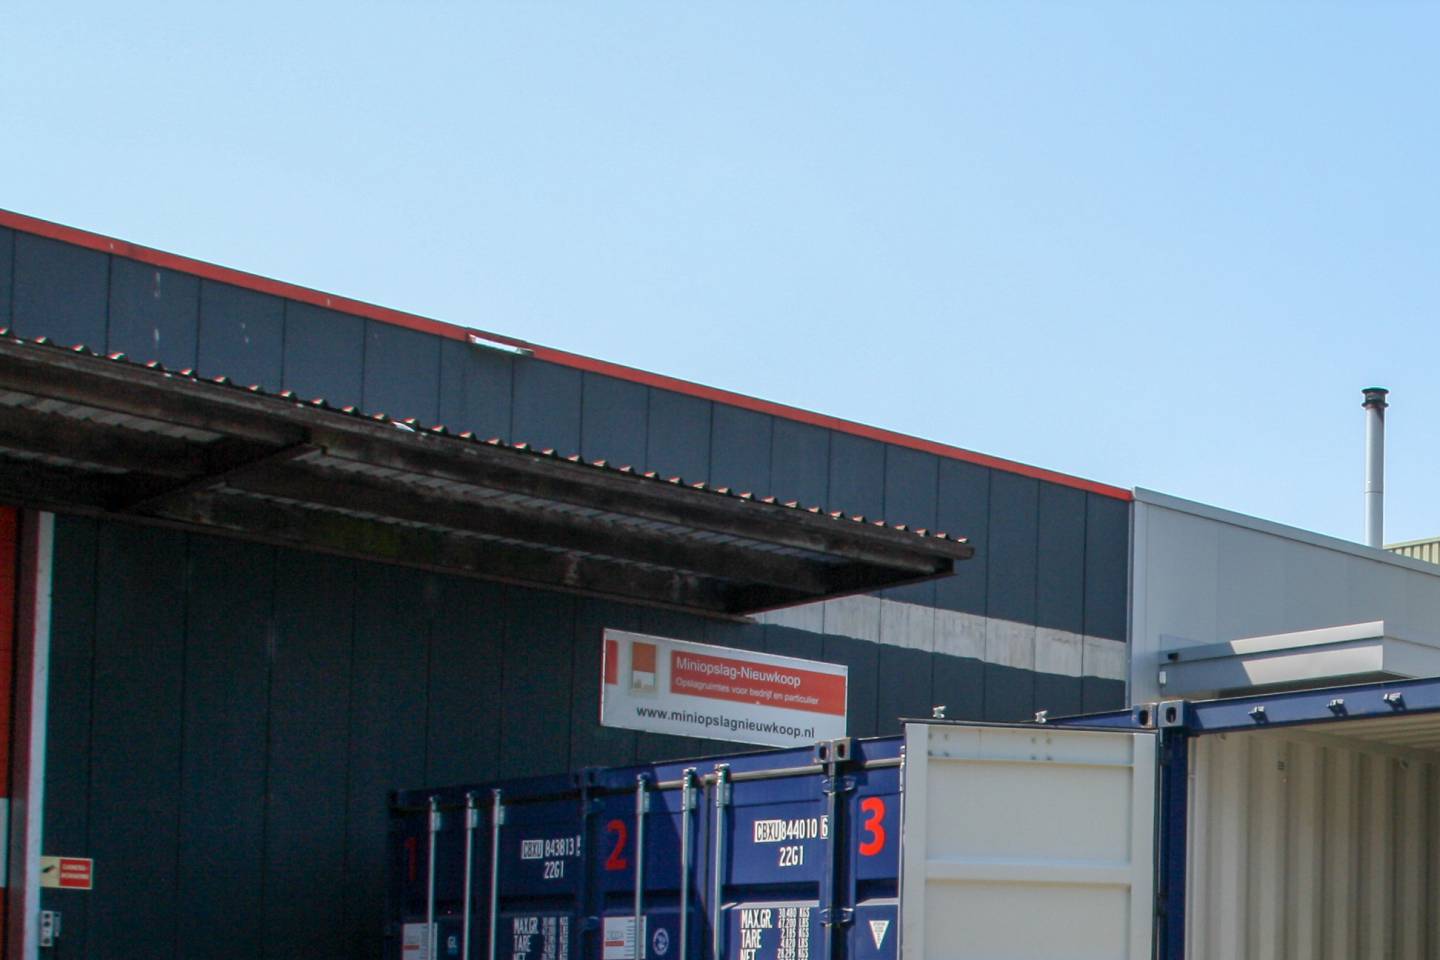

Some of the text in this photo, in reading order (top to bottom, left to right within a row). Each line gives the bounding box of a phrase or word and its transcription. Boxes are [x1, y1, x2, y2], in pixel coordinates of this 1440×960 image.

[676, 656, 801, 688] Miniopslag-Nieuwkoop
[731, 686, 748, 695] voor
[749, 687, 772, 699] bedrijf
[784, 693, 819, 705] particulier
[636, 706, 815, 739] www.miniopslagnieuwkoop.nl
[860, 797, 885, 856] 3
[605, 819, 627, 871] 2
[779, 845, 804, 867] 22G1
[404, 838, 417, 880] 1
[544, 861, 564, 879] 22G1
[513, 934, 531, 952] TARE
[741, 929, 762, 948] TARE
